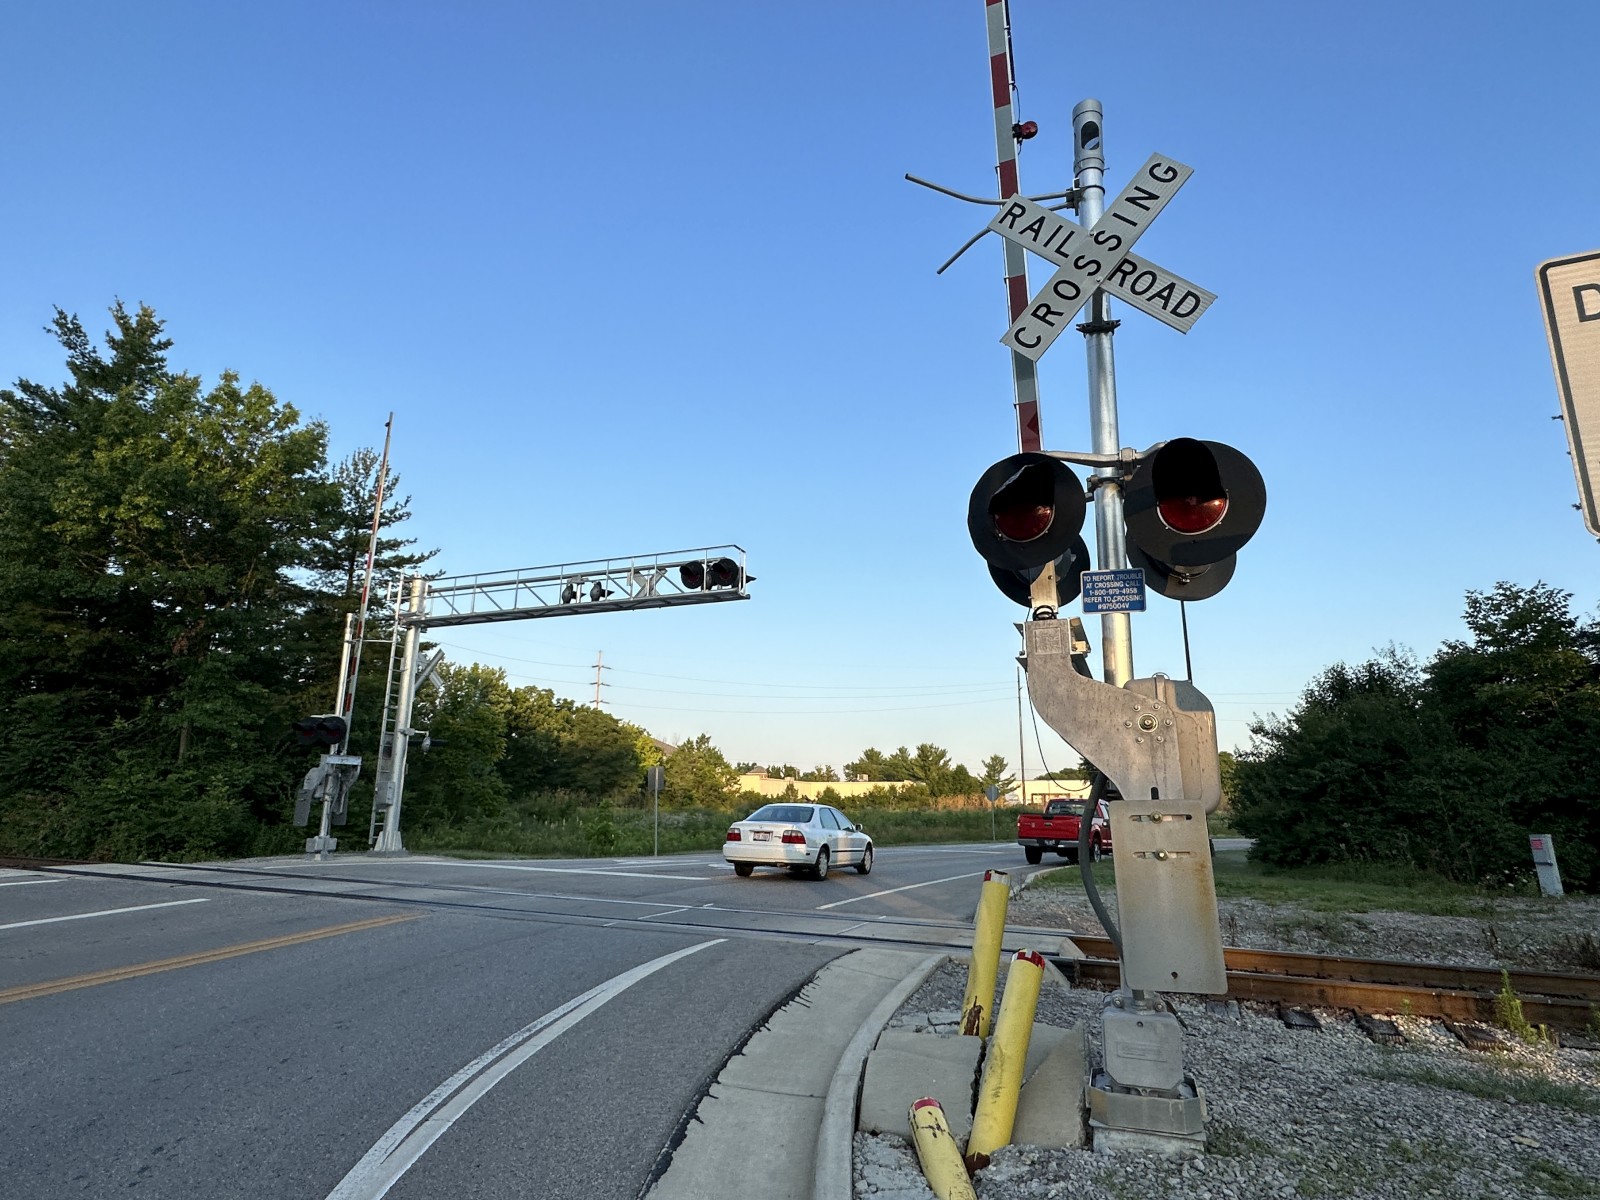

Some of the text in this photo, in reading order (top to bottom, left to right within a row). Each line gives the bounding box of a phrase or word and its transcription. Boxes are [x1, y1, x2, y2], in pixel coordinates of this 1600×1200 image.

[1013, 162, 1179, 349] CROSSING
[999, 201, 1201, 319] RAIL ROAD
[1092, 574, 1114, 582] REPORT
[1094, 581, 1124, 589] CROSSING
[1112, 595, 1143, 603] CROSSING
